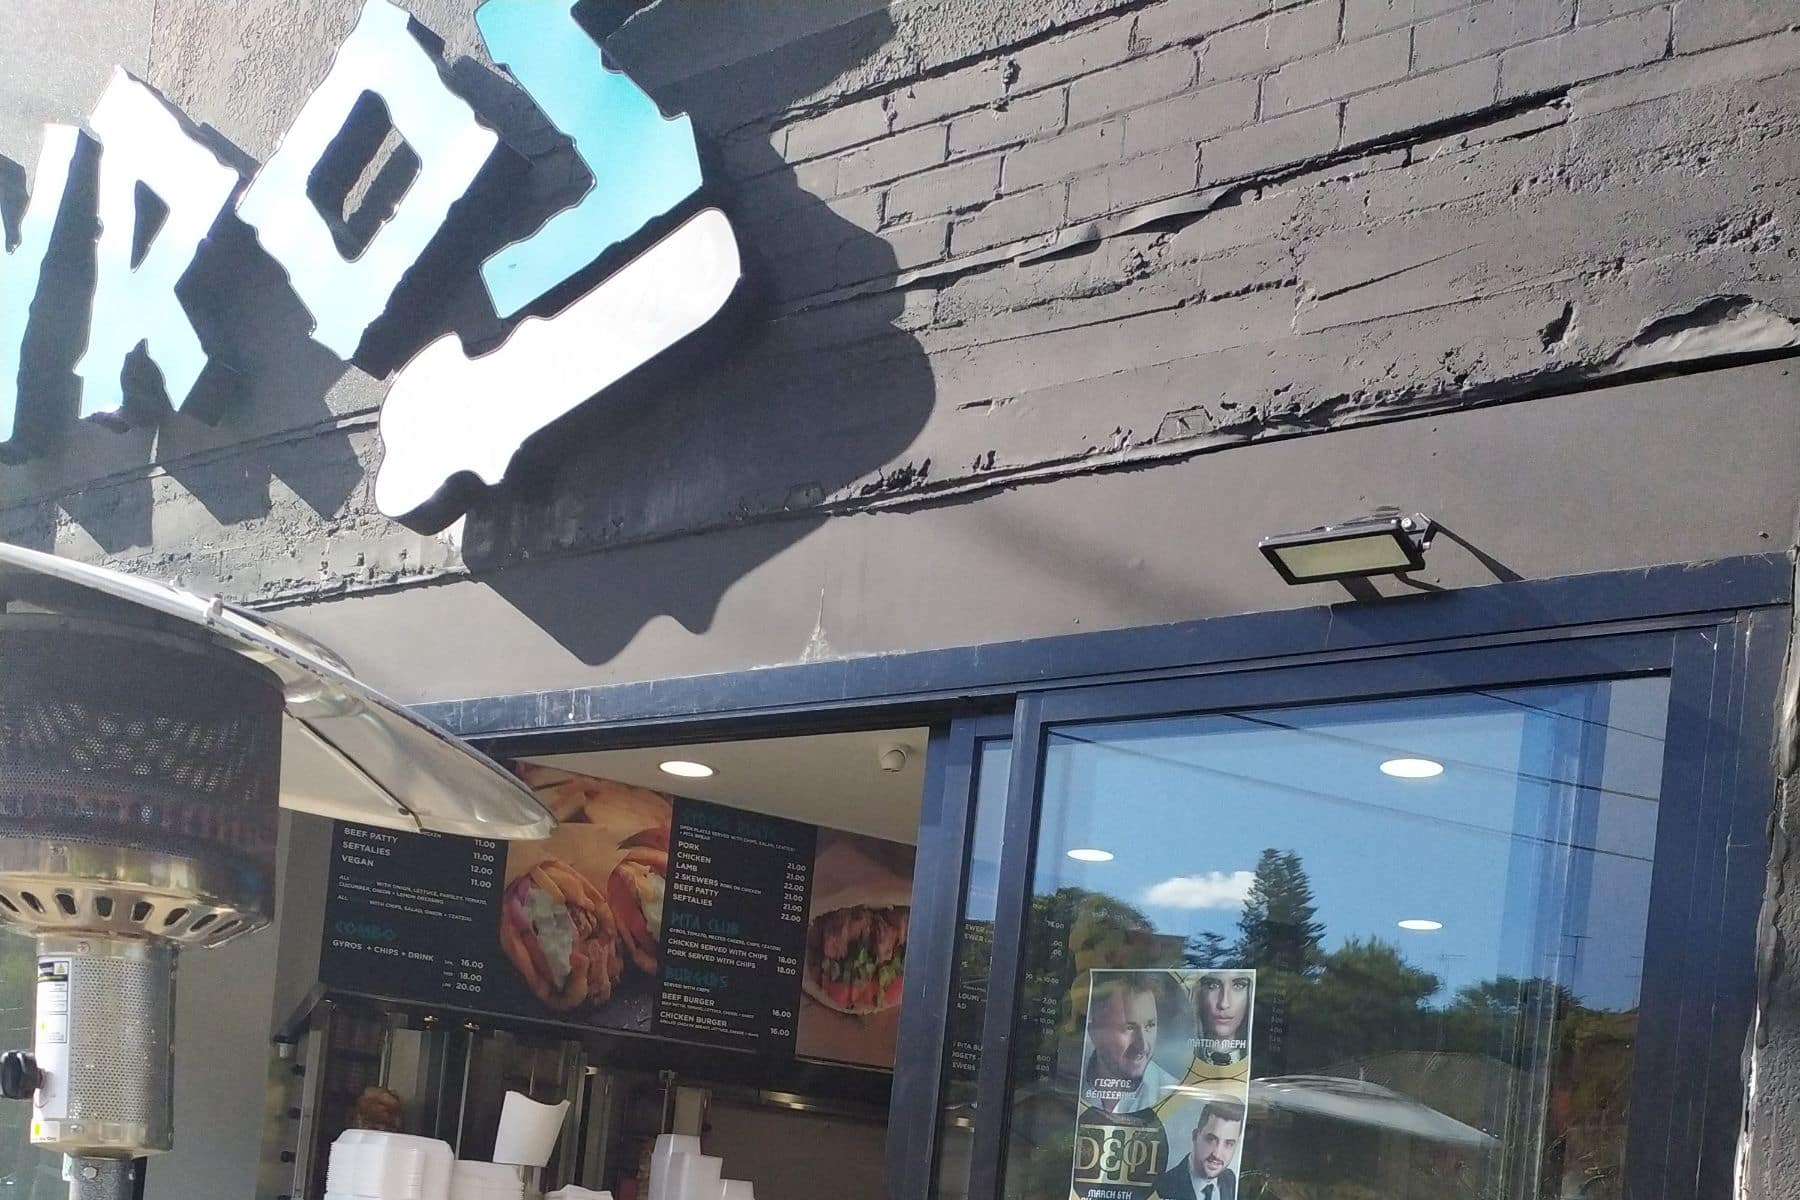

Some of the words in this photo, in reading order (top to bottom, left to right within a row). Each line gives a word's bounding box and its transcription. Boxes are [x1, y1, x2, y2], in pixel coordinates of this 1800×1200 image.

[344, 827, 368, 838] BEEF
[369, 832, 398, 844] PATTY
[473, 852, 495, 863] 11.00
[474, 839, 496, 849] 11.00
[678, 841, 700, 851] PORK
[787, 862, 806, 872] 21.00
[342, 841, 391, 857] SEFTALIES
[470, 864, 493, 876] 12.00
[677, 852, 712, 864] CHICKEN
[786, 872, 805, 882] 21.00
[341, 854, 374, 867] VEGAN
[470, 878, 492, 889] 11.00
[676, 862, 698, 872] LAMB
[783, 882, 804, 892] 22.00
[681, 874, 719, 887] SKEWERS
[672, 893, 713, 907] SEFTALIES
[780, 913, 801, 923] 22.00
[673, 883, 694, 892] BEEF
[695, 886, 719, 897] PATTY
[783, 903, 802, 912] 21.00
[332, 939, 363, 950] GYROS
[373, 946, 399, 956] CHIPS
[408, 951, 434, 962] DRINK
[460, 958, 484, 969] 16.00
[667, 938, 699, 949] CHICKEN
[700, 942, 727, 954] SERVED
[728, 947, 747, 957] WITH
[748, 951, 768, 960] CHIPS
[667, 948, 687, 957] PORK
[688, 951, 715, 962] SERVED
[716, 956, 734, 965] WITH
[736, 960, 756, 969] CHIPS
[456, 982, 481, 993] 20.00
[459, 971, 482, 982] 18.00
[662, 992, 682, 1001] BEEF
[683, 995, 715, 1007] BURGER
[660, 1011, 694, 1023] CHICKEN
[696, 1016, 727, 1027] BURGER
[1088, 1189, 1116, 1198] MARCH
